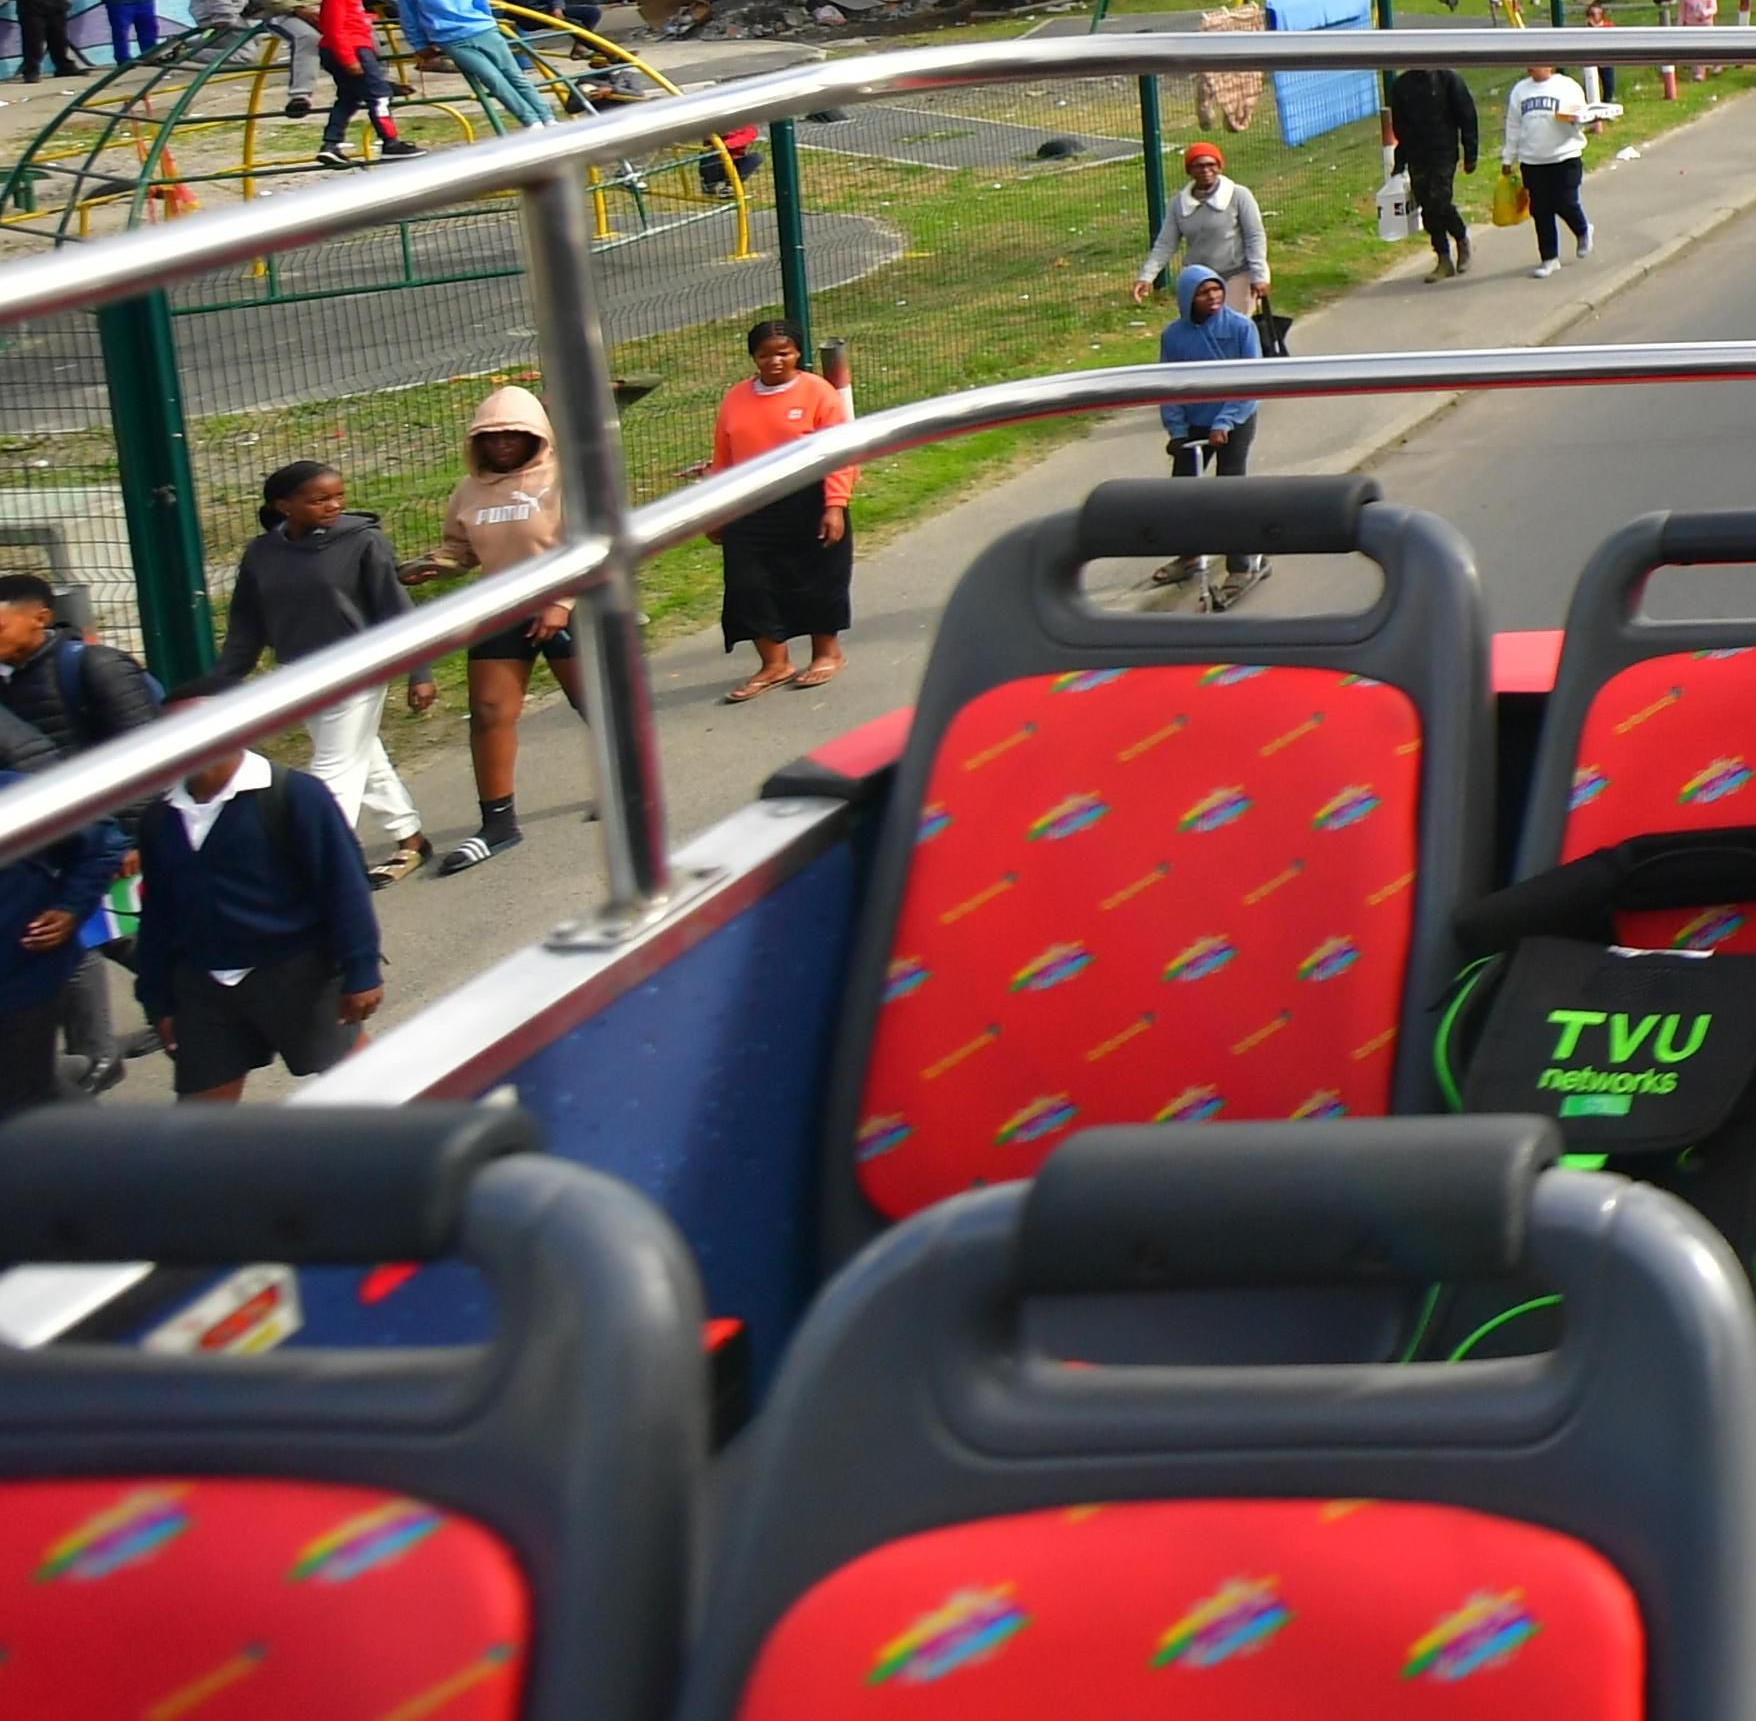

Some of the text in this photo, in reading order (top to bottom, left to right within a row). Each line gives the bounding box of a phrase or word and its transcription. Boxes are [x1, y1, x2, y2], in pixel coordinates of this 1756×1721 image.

[476, 503, 530, 526] PUMA
[1547, 1009, 1712, 1064] TVU
[1536, 1065, 1680, 1095] networks
